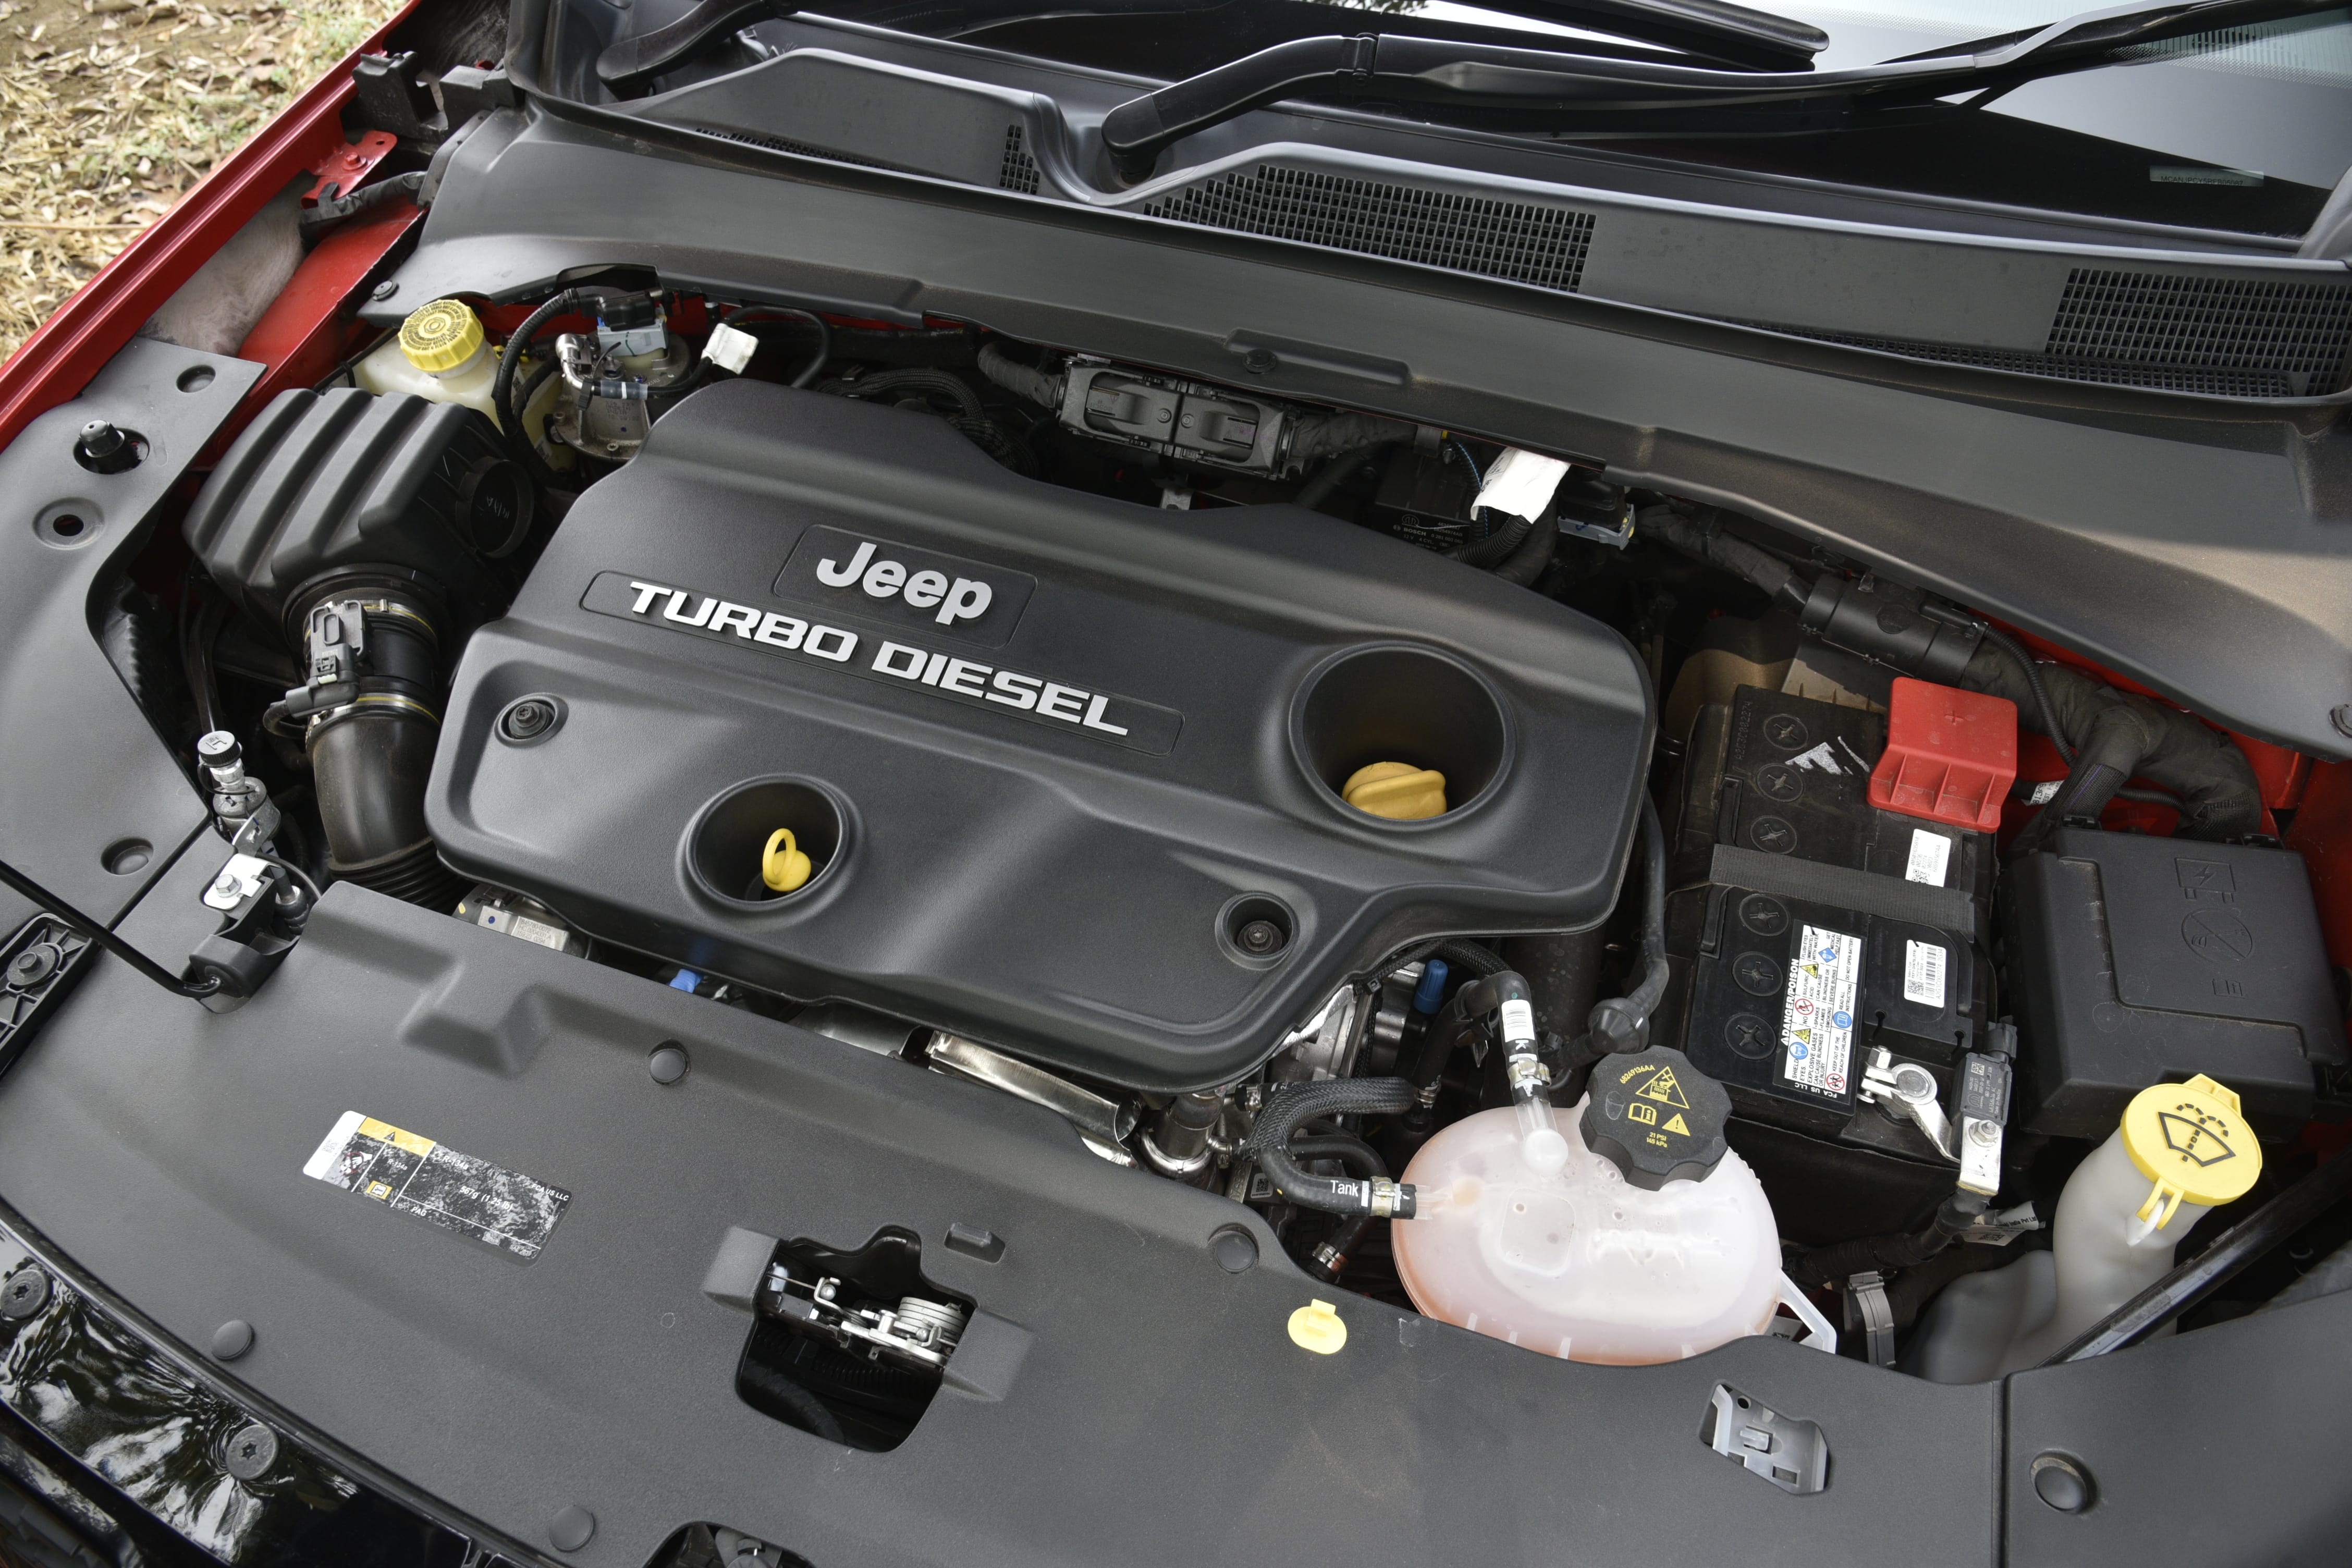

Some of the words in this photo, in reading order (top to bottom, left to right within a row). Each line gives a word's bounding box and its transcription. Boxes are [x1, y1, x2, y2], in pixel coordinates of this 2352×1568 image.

[1403, 526, 1426, 536] BOSCH
[816, 542, 992, 626] Jeep
[630, 581, 859, 662] TURBO
[871, 640, 1128, 736] DIESEL
[1782, 958, 1799, 1036] DANGER/POISON
[1620, 1064, 1655, 1084] 68249136AA
[1823, 1089, 1837, 1098] FCA
[387, 1158, 408, 1171] R-134a
[442, 1155, 469, 1170] R-134a
[531, 1183, 545, 1193] FCA
[545, 1188, 555, 1196] US
[555, 1192, 569, 1202] LLC
[1330, 1180, 1358, 1197] Tank
[459, 1185, 479, 1199] 567g
[480, 1193, 501, 1207] (1.25
[500, 1200, 513, 1212] lb)
[411, 1206, 427, 1217] PAG
